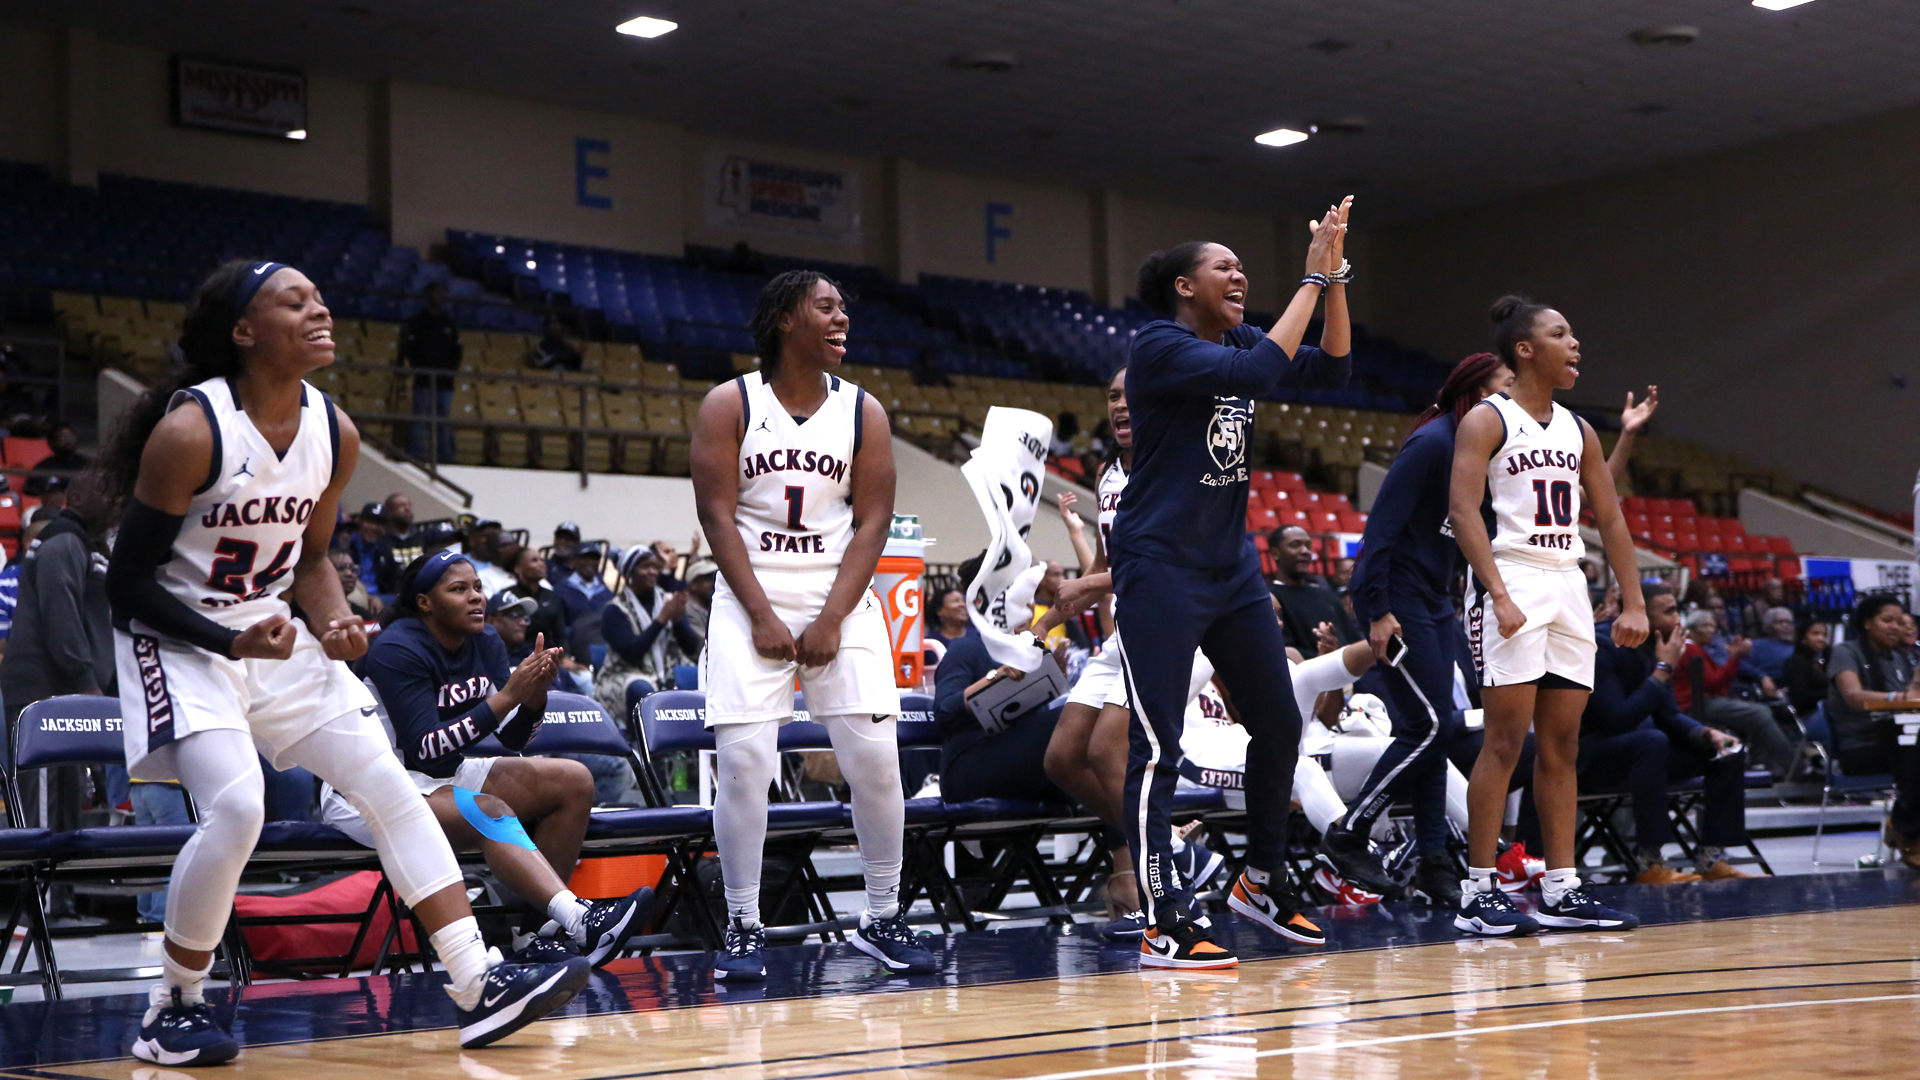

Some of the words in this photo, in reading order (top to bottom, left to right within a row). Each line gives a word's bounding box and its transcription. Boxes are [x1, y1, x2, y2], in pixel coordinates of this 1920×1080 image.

[575, 136, 612, 208] E
[986, 203, 1013, 263] F
[744, 449, 847, 484] JACKSON
[1506, 449, 1580, 476] JACKSO
[785, 485, 808, 531] 1
[1533, 479, 1572, 527] 10
[760, 531, 825, 553] STATE
[1527, 533, 1572, 550] STATE
[895, 579, 919, 617] G
[137, 638, 171, 733] TIGERS
[40, 718, 101, 731] JACKSON
[567, 710, 603, 723] STATE
[654, 708, 697, 721] JACKSON
[418, 716, 480, 761] STATE
[1200, 769, 1244, 789] TIGERS
[1149, 853, 1164, 898] TIGERS
